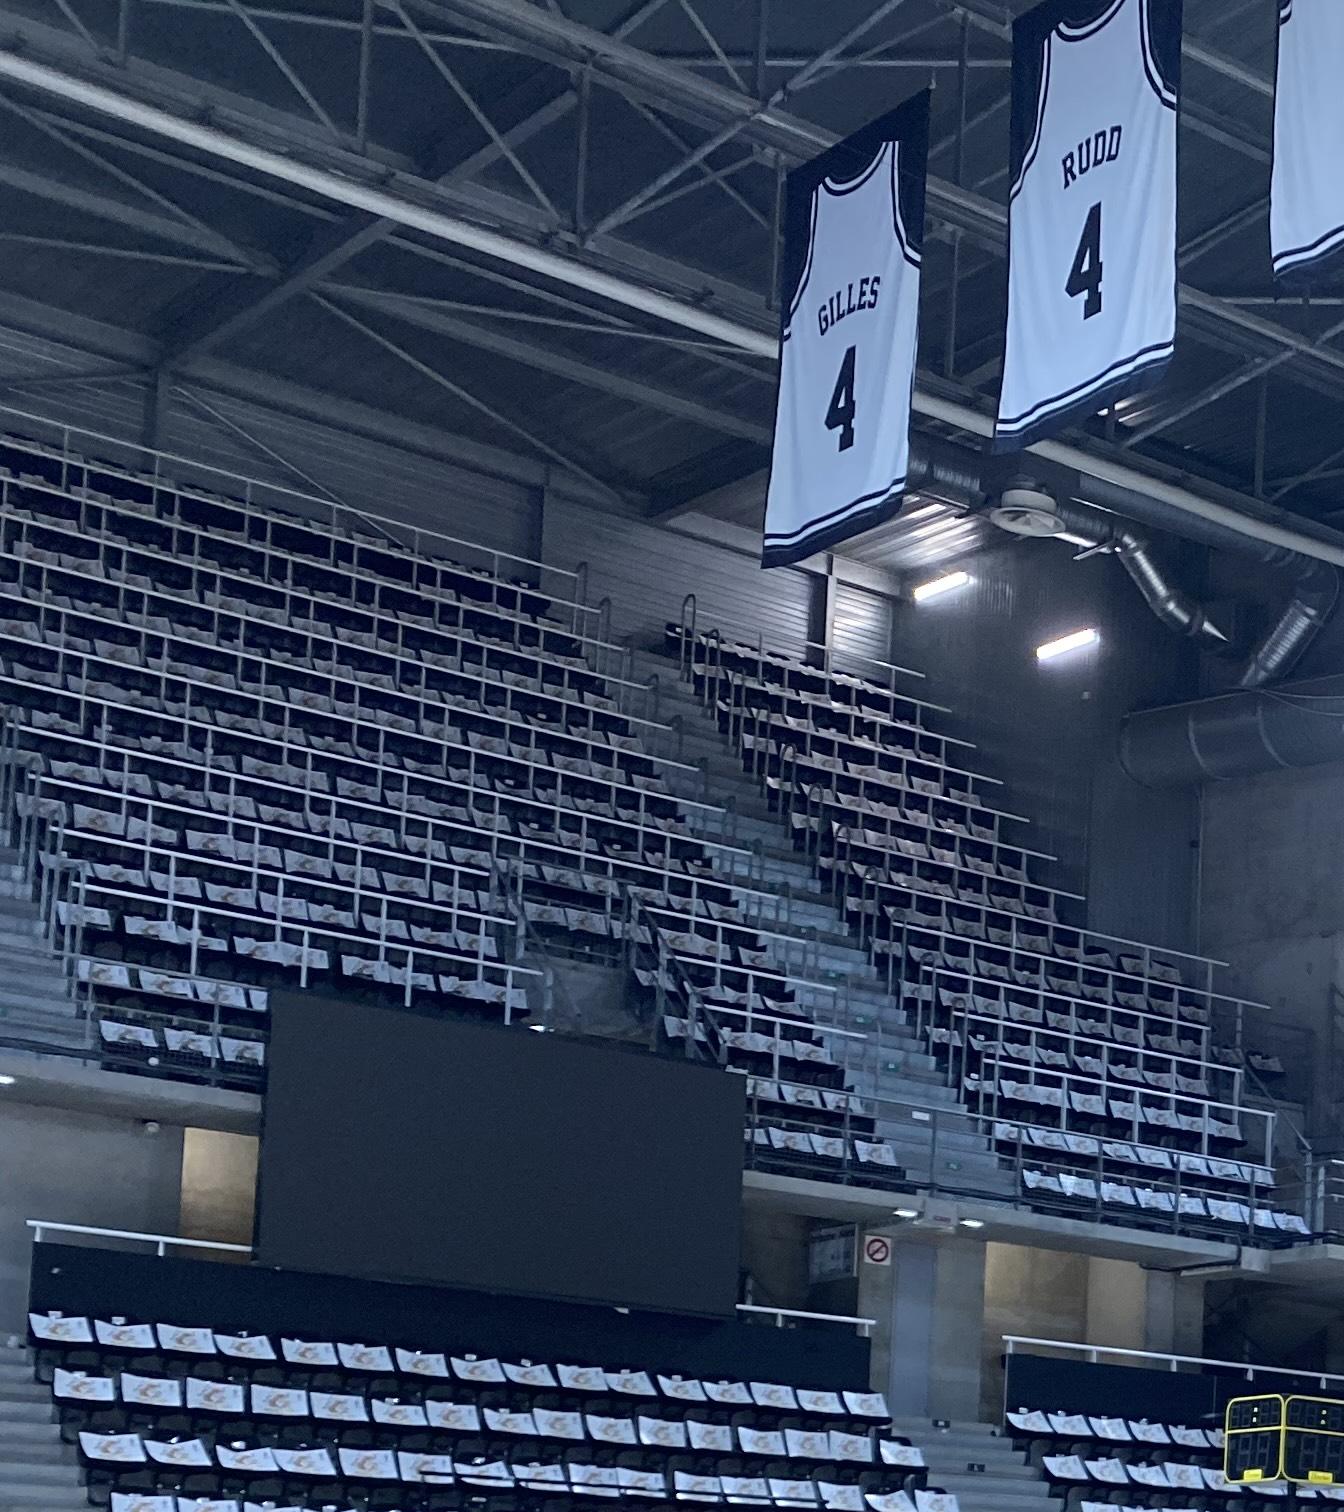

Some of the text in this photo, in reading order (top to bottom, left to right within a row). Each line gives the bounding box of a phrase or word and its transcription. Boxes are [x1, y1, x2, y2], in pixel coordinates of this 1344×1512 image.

[1061, 124, 1123, 190] RUDD
[1064, 202, 1104, 321] 4
[817, 275, 881, 337] GILLES
[823, 344, 858, 453] 4
